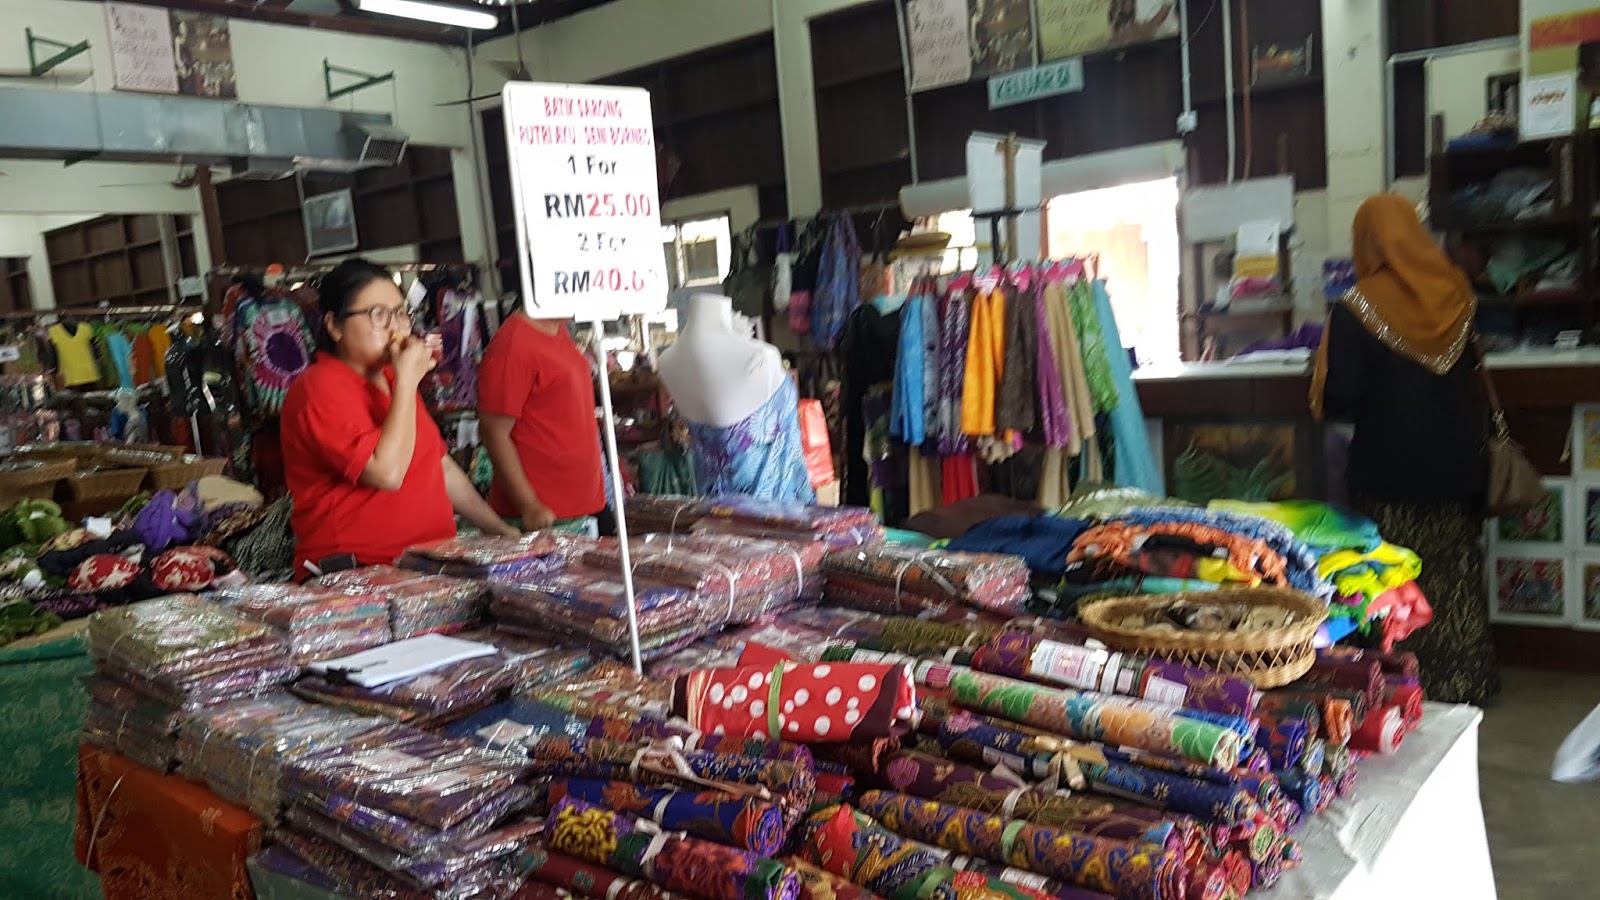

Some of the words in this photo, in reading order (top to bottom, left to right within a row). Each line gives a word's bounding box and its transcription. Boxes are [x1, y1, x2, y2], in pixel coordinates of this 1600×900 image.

[543, 96, 574, 118] BATIK
[577, 97, 622, 119] SARONG
[567, 154, 577, 176] 1
[586, 154, 618, 176] For
[543, 192, 651, 219] RM25.00
[577, 231, 590, 252] 2
[596, 231, 627, 252] For
[553, 266, 658, 295] RM40.0
